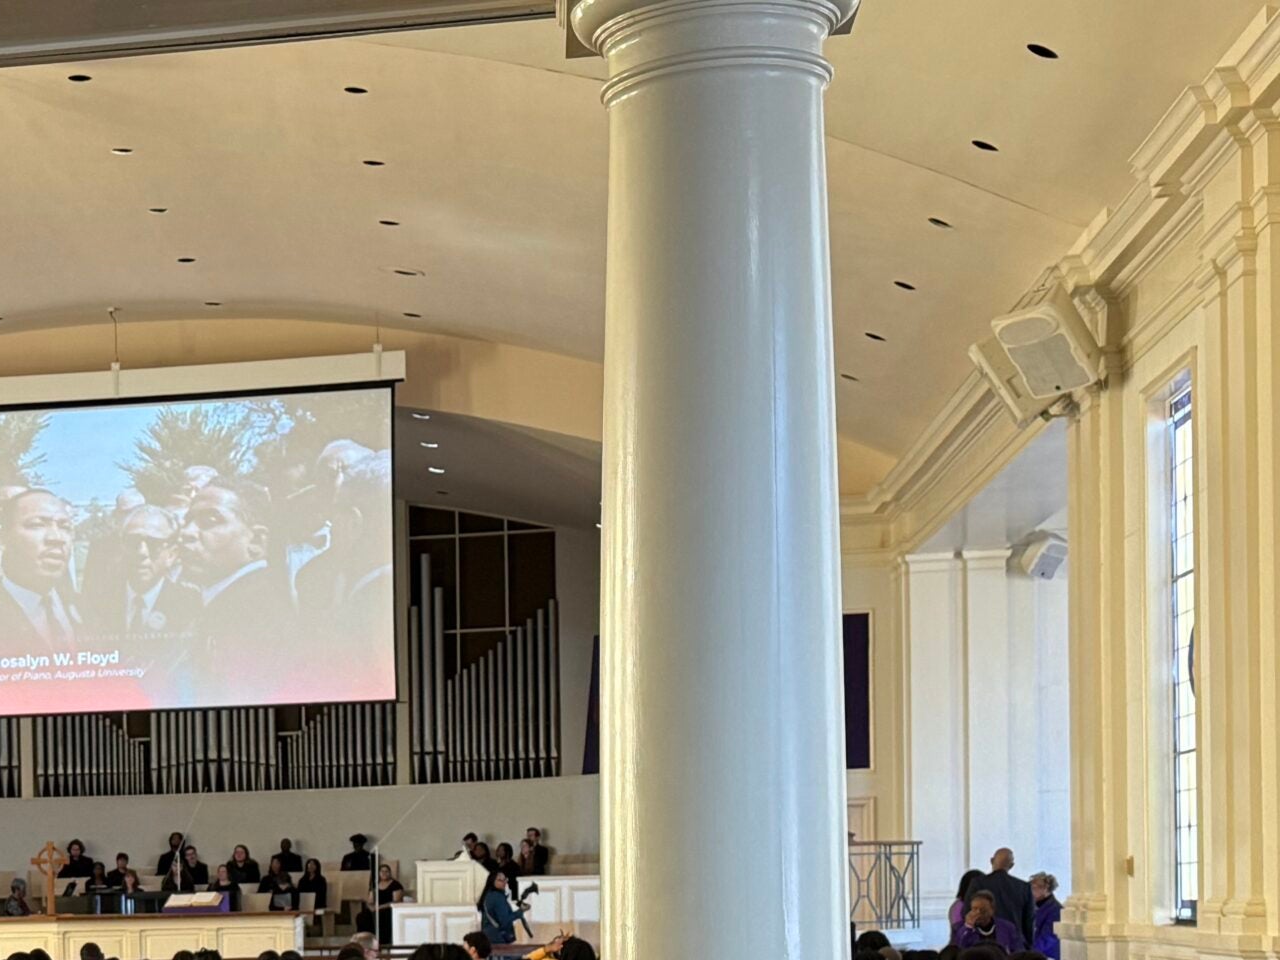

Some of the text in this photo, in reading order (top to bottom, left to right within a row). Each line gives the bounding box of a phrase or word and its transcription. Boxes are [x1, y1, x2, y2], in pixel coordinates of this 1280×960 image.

[53, 653, 74, 666] W.
[78, 650, 120, 666] Floyd
[11, 670, 23, 681] of
[54, 668, 96, 682] Augusta
[97, 667, 145, 680] University
